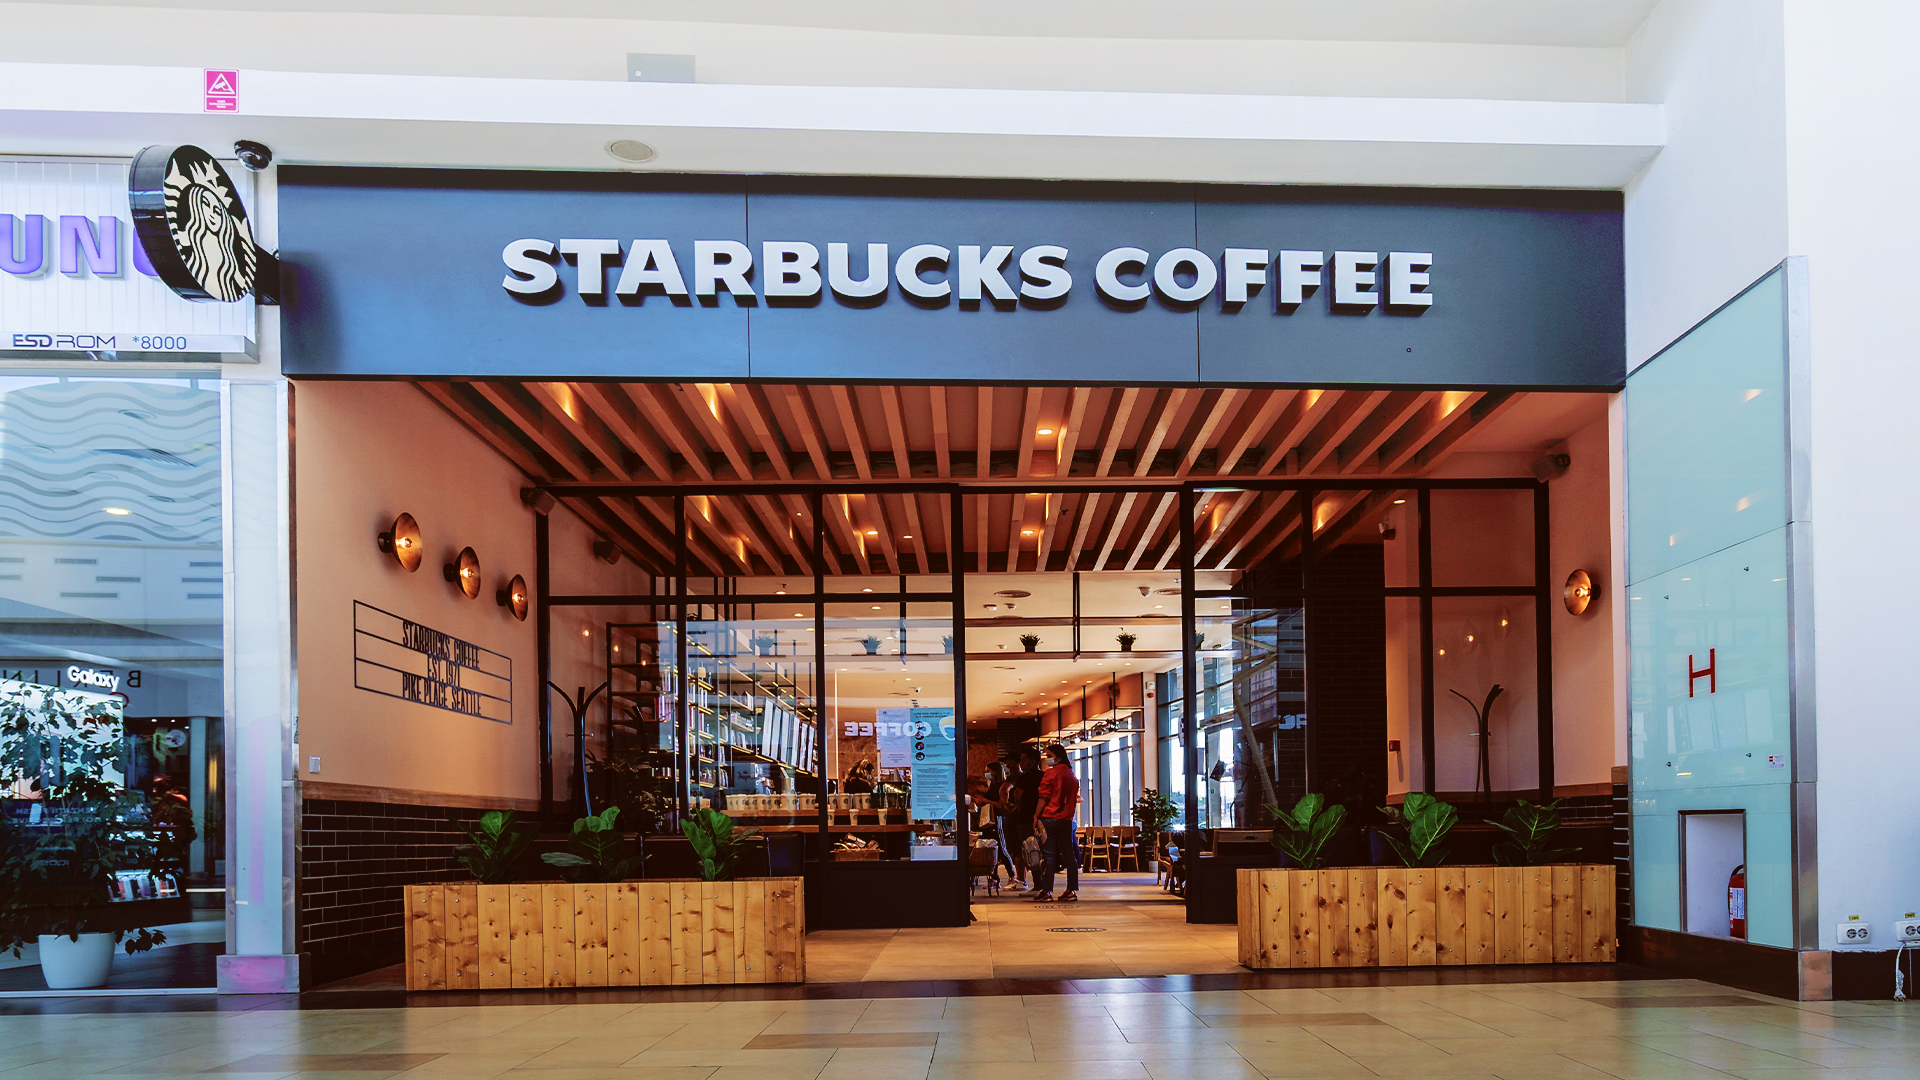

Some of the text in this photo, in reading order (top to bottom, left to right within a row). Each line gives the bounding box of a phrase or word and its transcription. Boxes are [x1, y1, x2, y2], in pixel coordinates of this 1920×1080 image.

[0, 213, 159, 278] UN
[501, 238, 1434, 310] STARBUCKS COFFEE
[402, 619, 480, 671] STARBUCKS COFFEE
[66, 665, 120, 693] Galaxy
[402, 672, 482, 717] PIKE PLACE SEATTLE
[445, 660, 461, 691] 1971
[1688, 647, 1716, 699] H
